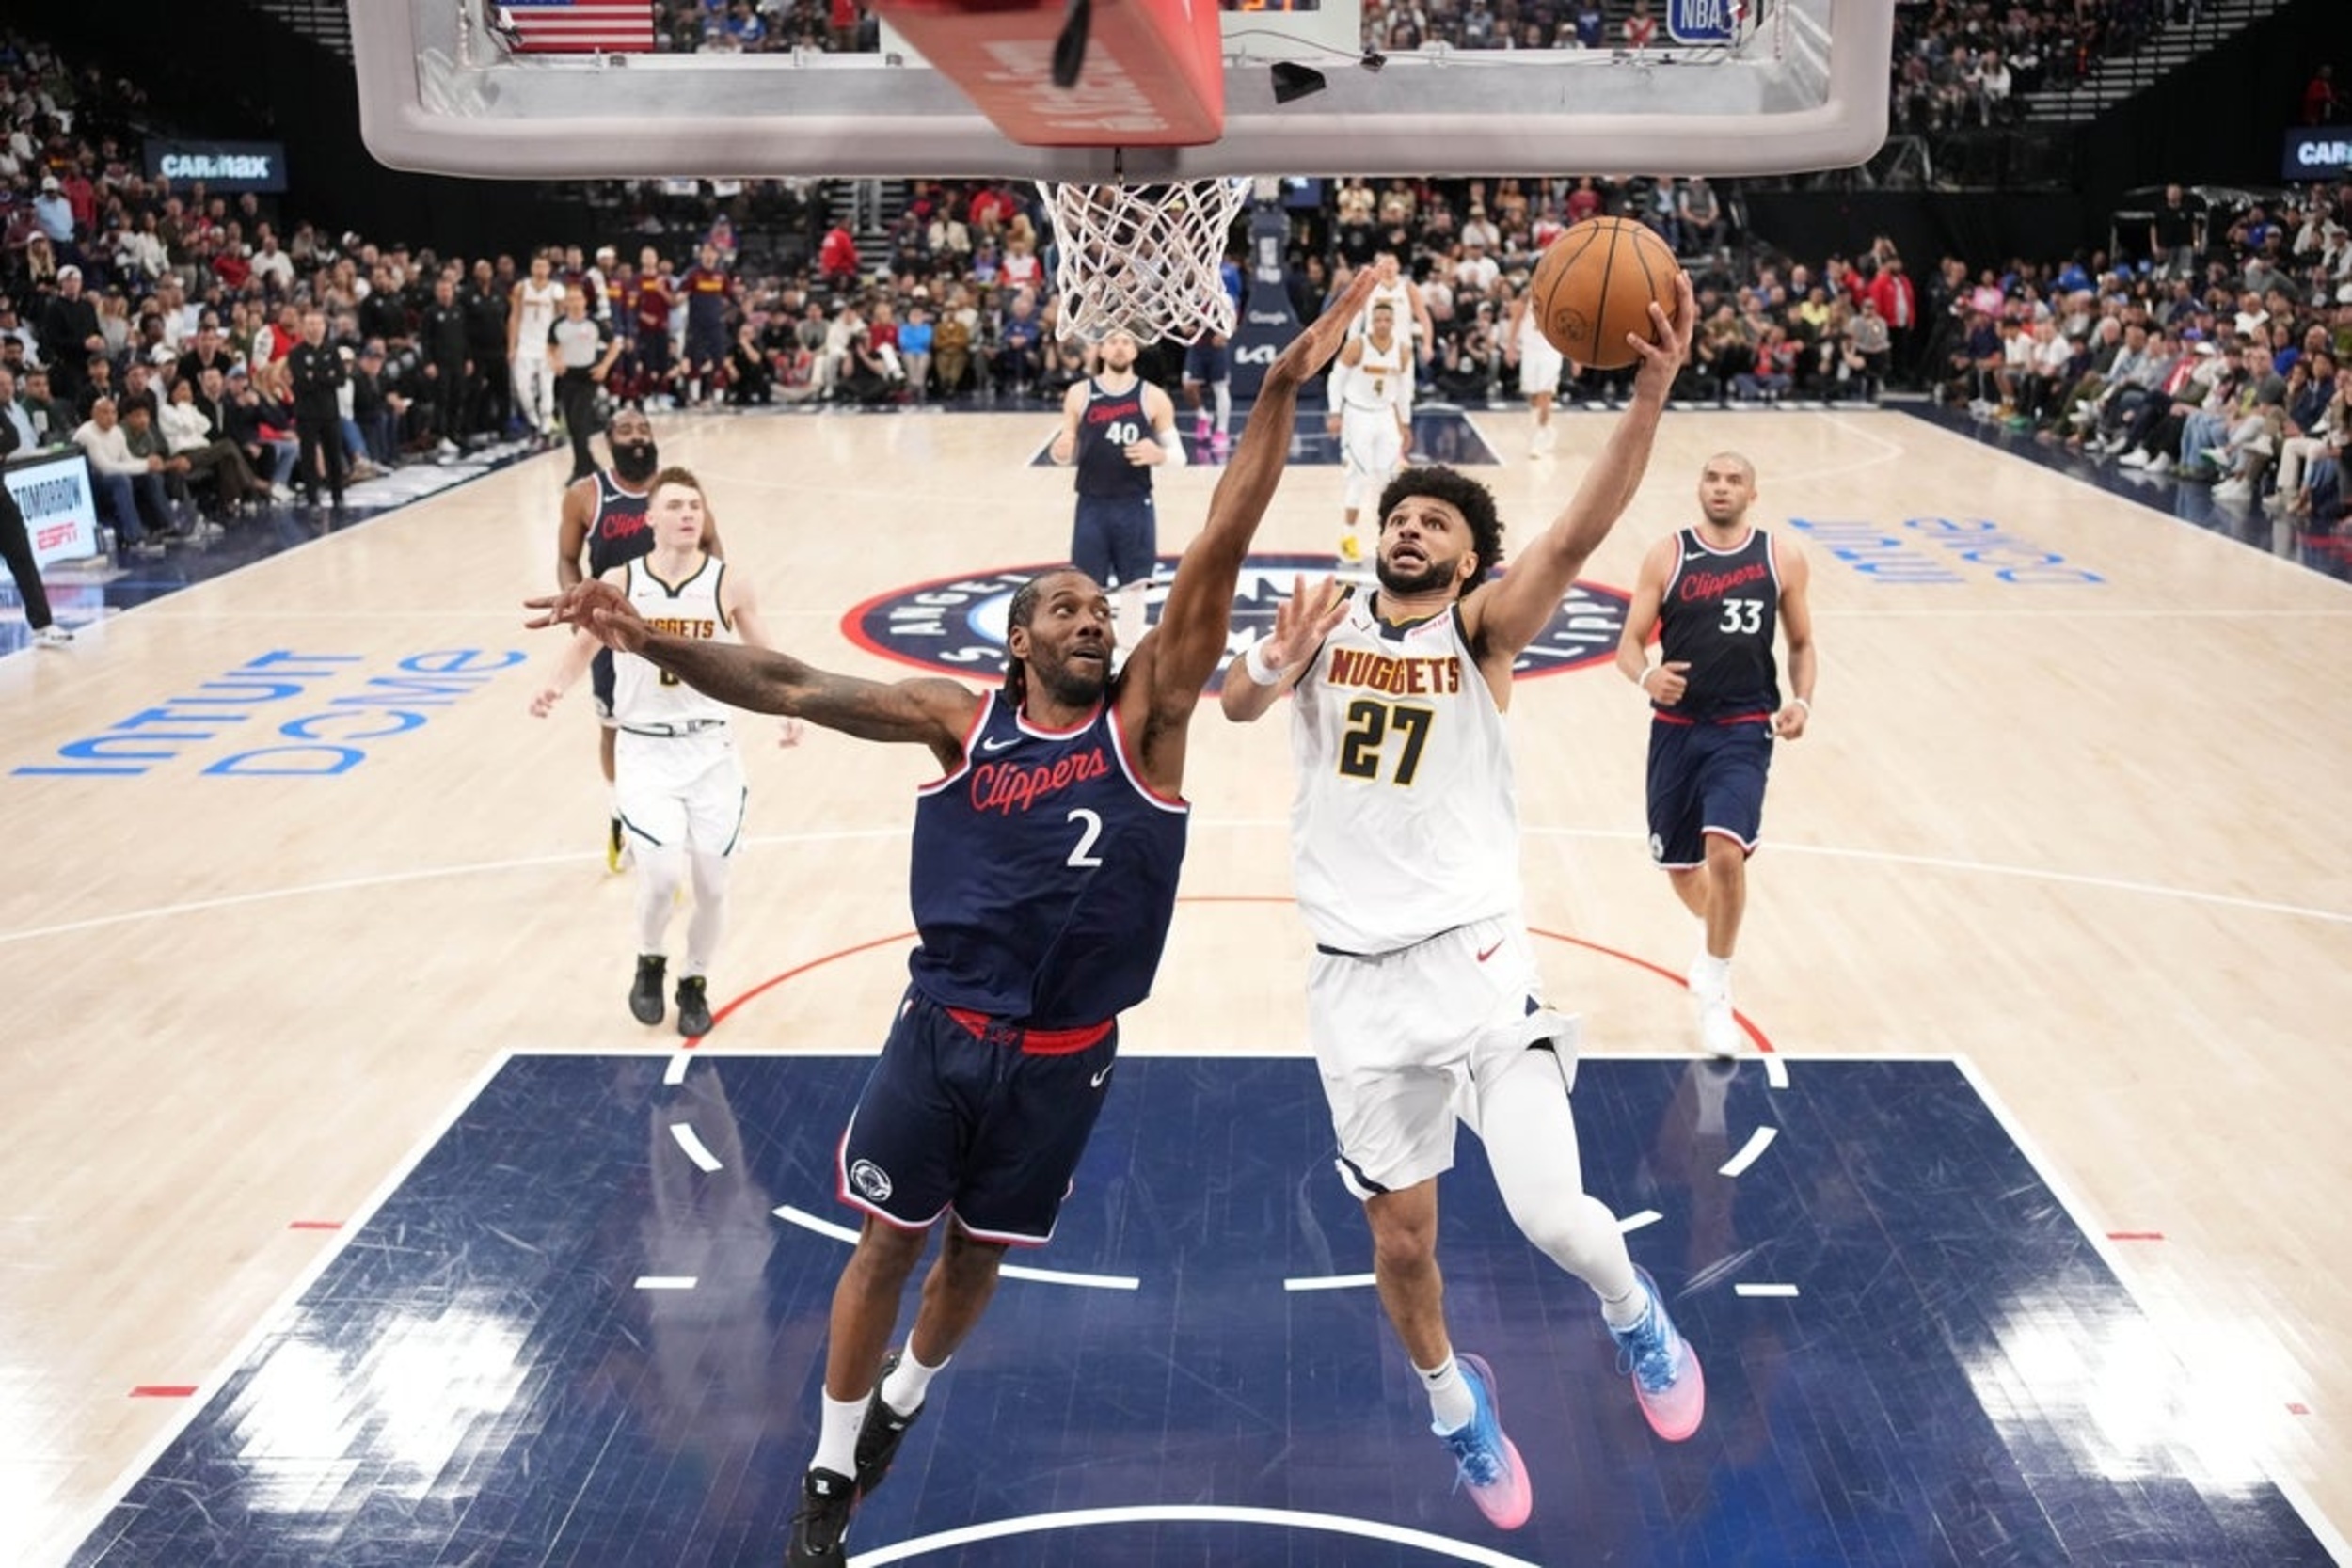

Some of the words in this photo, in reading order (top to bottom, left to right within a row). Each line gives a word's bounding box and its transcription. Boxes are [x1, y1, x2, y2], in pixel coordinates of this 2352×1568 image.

[1680, 0, 1721, 29] NBA
[2298, 141, 2352, 165] CAR
[1248, 310, 1287, 325] Google
[1105, 421, 1140, 445] 40
[13, 475, 82, 520] TOMORROW
[37, 522, 78, 550] ESPN
[603, 514, 646, 539] Clipp
[1680, 563, 1766, 602] Clippers
[1719, 598, 1764, 634] 33
[1327, 647, 1460, 696] NUGGETS
[1337, 697, 1436, 789] 27
[971, 748, 1109, 816] Clippers
[1067, 808, 1103, 867] 2
